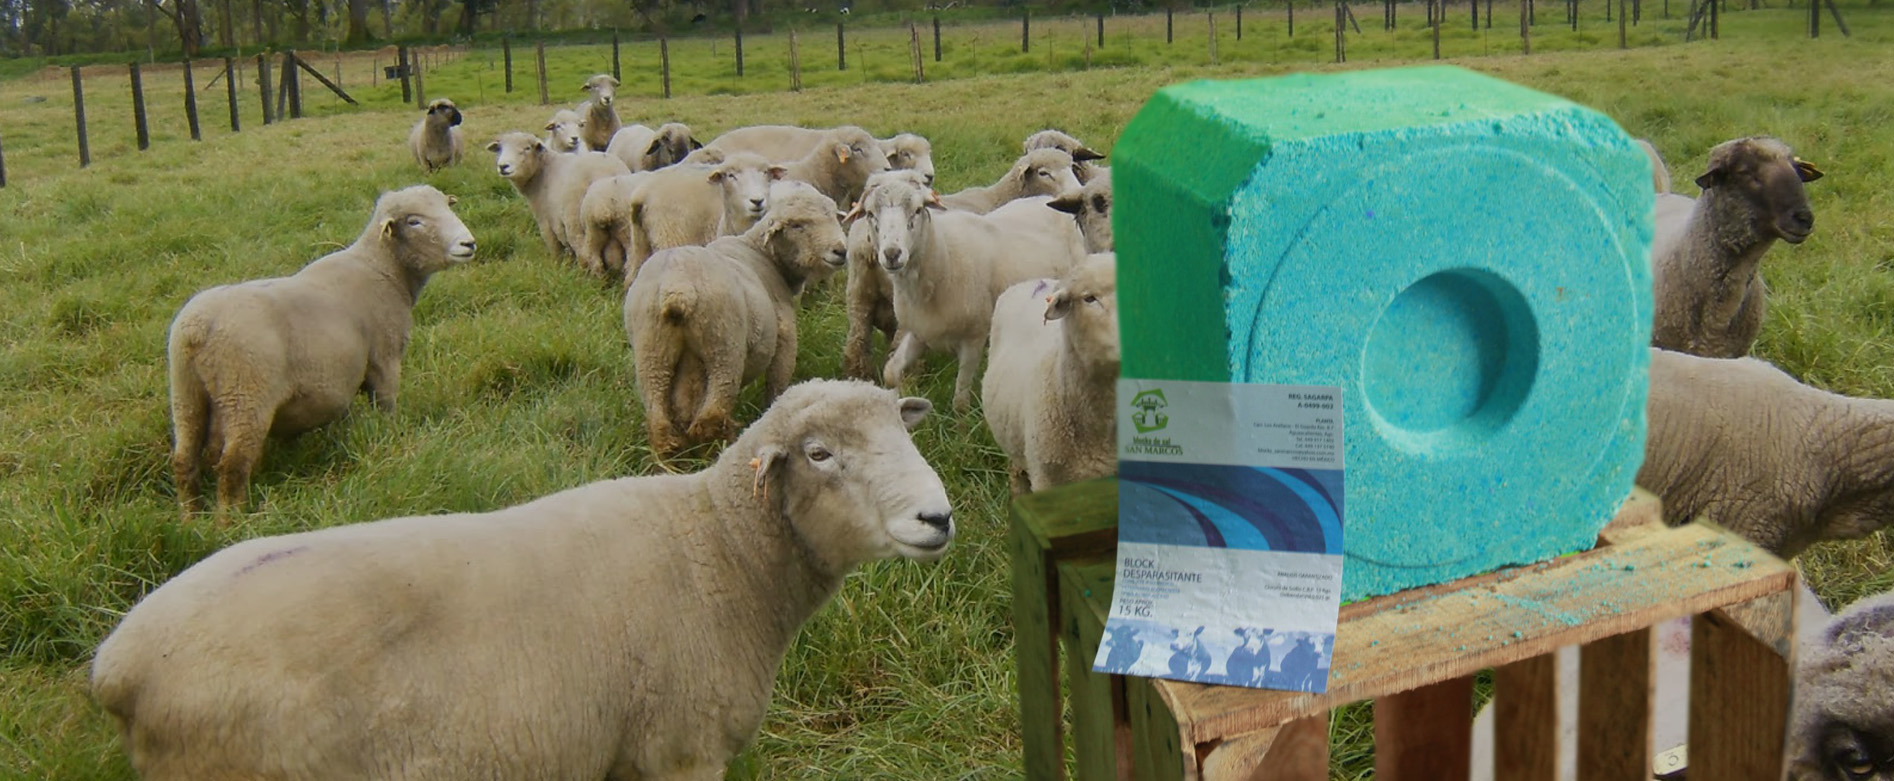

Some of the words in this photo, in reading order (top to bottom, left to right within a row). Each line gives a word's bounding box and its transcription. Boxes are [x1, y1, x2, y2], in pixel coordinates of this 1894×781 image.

[1125, 445, 1142, 454] SAN
[1144, 446, 1183, 456] MARCOS
[1124, 557, 1155, 569] BLOCK
[1123, 569, 1202, 583] DESPARASITANTE
[1119, 605, 1131, 616] 15
[1134, 606, 1153, 618] KG.
